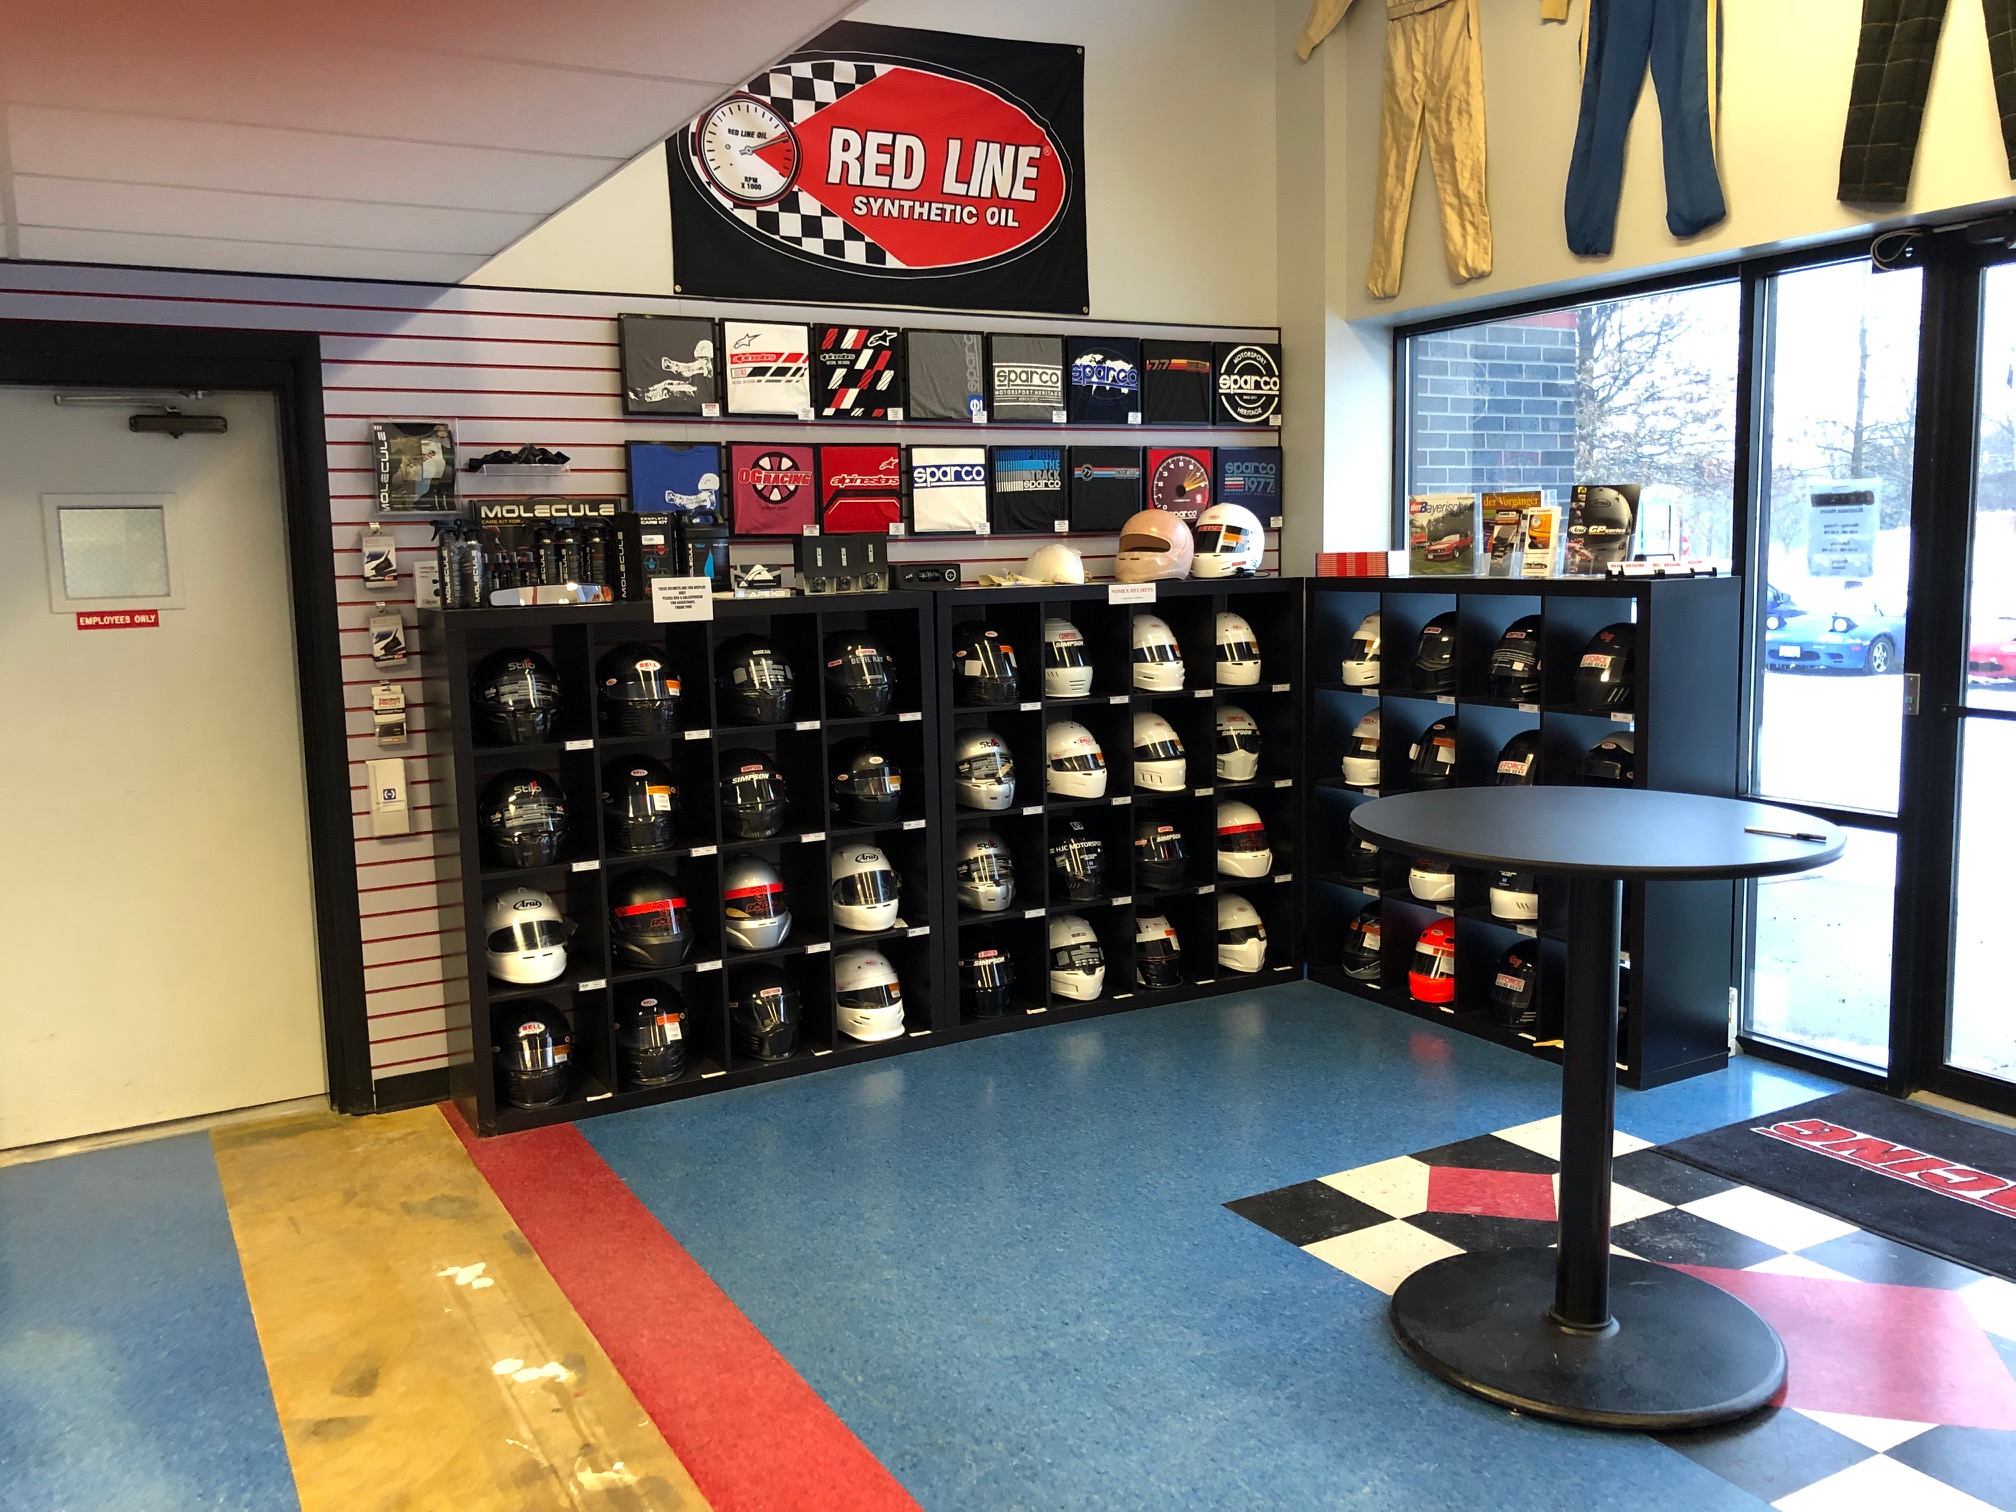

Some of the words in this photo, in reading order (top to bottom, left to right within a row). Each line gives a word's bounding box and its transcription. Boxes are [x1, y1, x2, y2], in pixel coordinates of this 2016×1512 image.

[826, 127, 926, 191] RED
[942, 138, 1042, 202] LINE
[852, 196, 979, 226] SYNTHETIC
[985, 205, 1020, 228] OIL
[1233, 351, 1267, 365] MOTORSPORT
[996, 368, 1060, 388] sparco
[1071, 363, 1138, 386] sparco
[1219, 374, 1280, 394] sparco
[1237, 407, 1263, 416] HERITAGE
[1027, 450, 1060, 460] PUNISH
[1044, 460, 1060, 469] THE
[1224, 461, 1276, 477] sparco
[830, 473, 900, 488] alpinestars
[913, 465, 985, 487] sparco
[1031, 470, 1061, 480] TRACK
[1023, 480, 1061, 491] sparco
[1244, 477, 1273, 492] 1977
[1410, 503, 1420, 512] der
[1484, 496, 1496, 506] der
[1498, 496, 1539, 508] Vorgänger
[480, 504, 615, 518] MOLECULE
[1170, 510, 1197, 518] parco
[617, 531, 627, 598] MOLECULE
[79, 615, 131, 626] EMPLOYEES
[134, 615, 156, 623] ONLY
[1056, 640, 1083, 648] SIMPSON
[508, 659, 536, 671] Stilo
[851, 656, 871, 664] DEVIL
[732, 773, 769, 784] SIMPSON
[514, 782, 542, 794] Stilo
[856, 853, 878, 862] Arai
[515, 900, 540, 909] Arai
[974, 957, 1004, 966] SIMPSON
[522, 1024, 542, 1032] BELL
